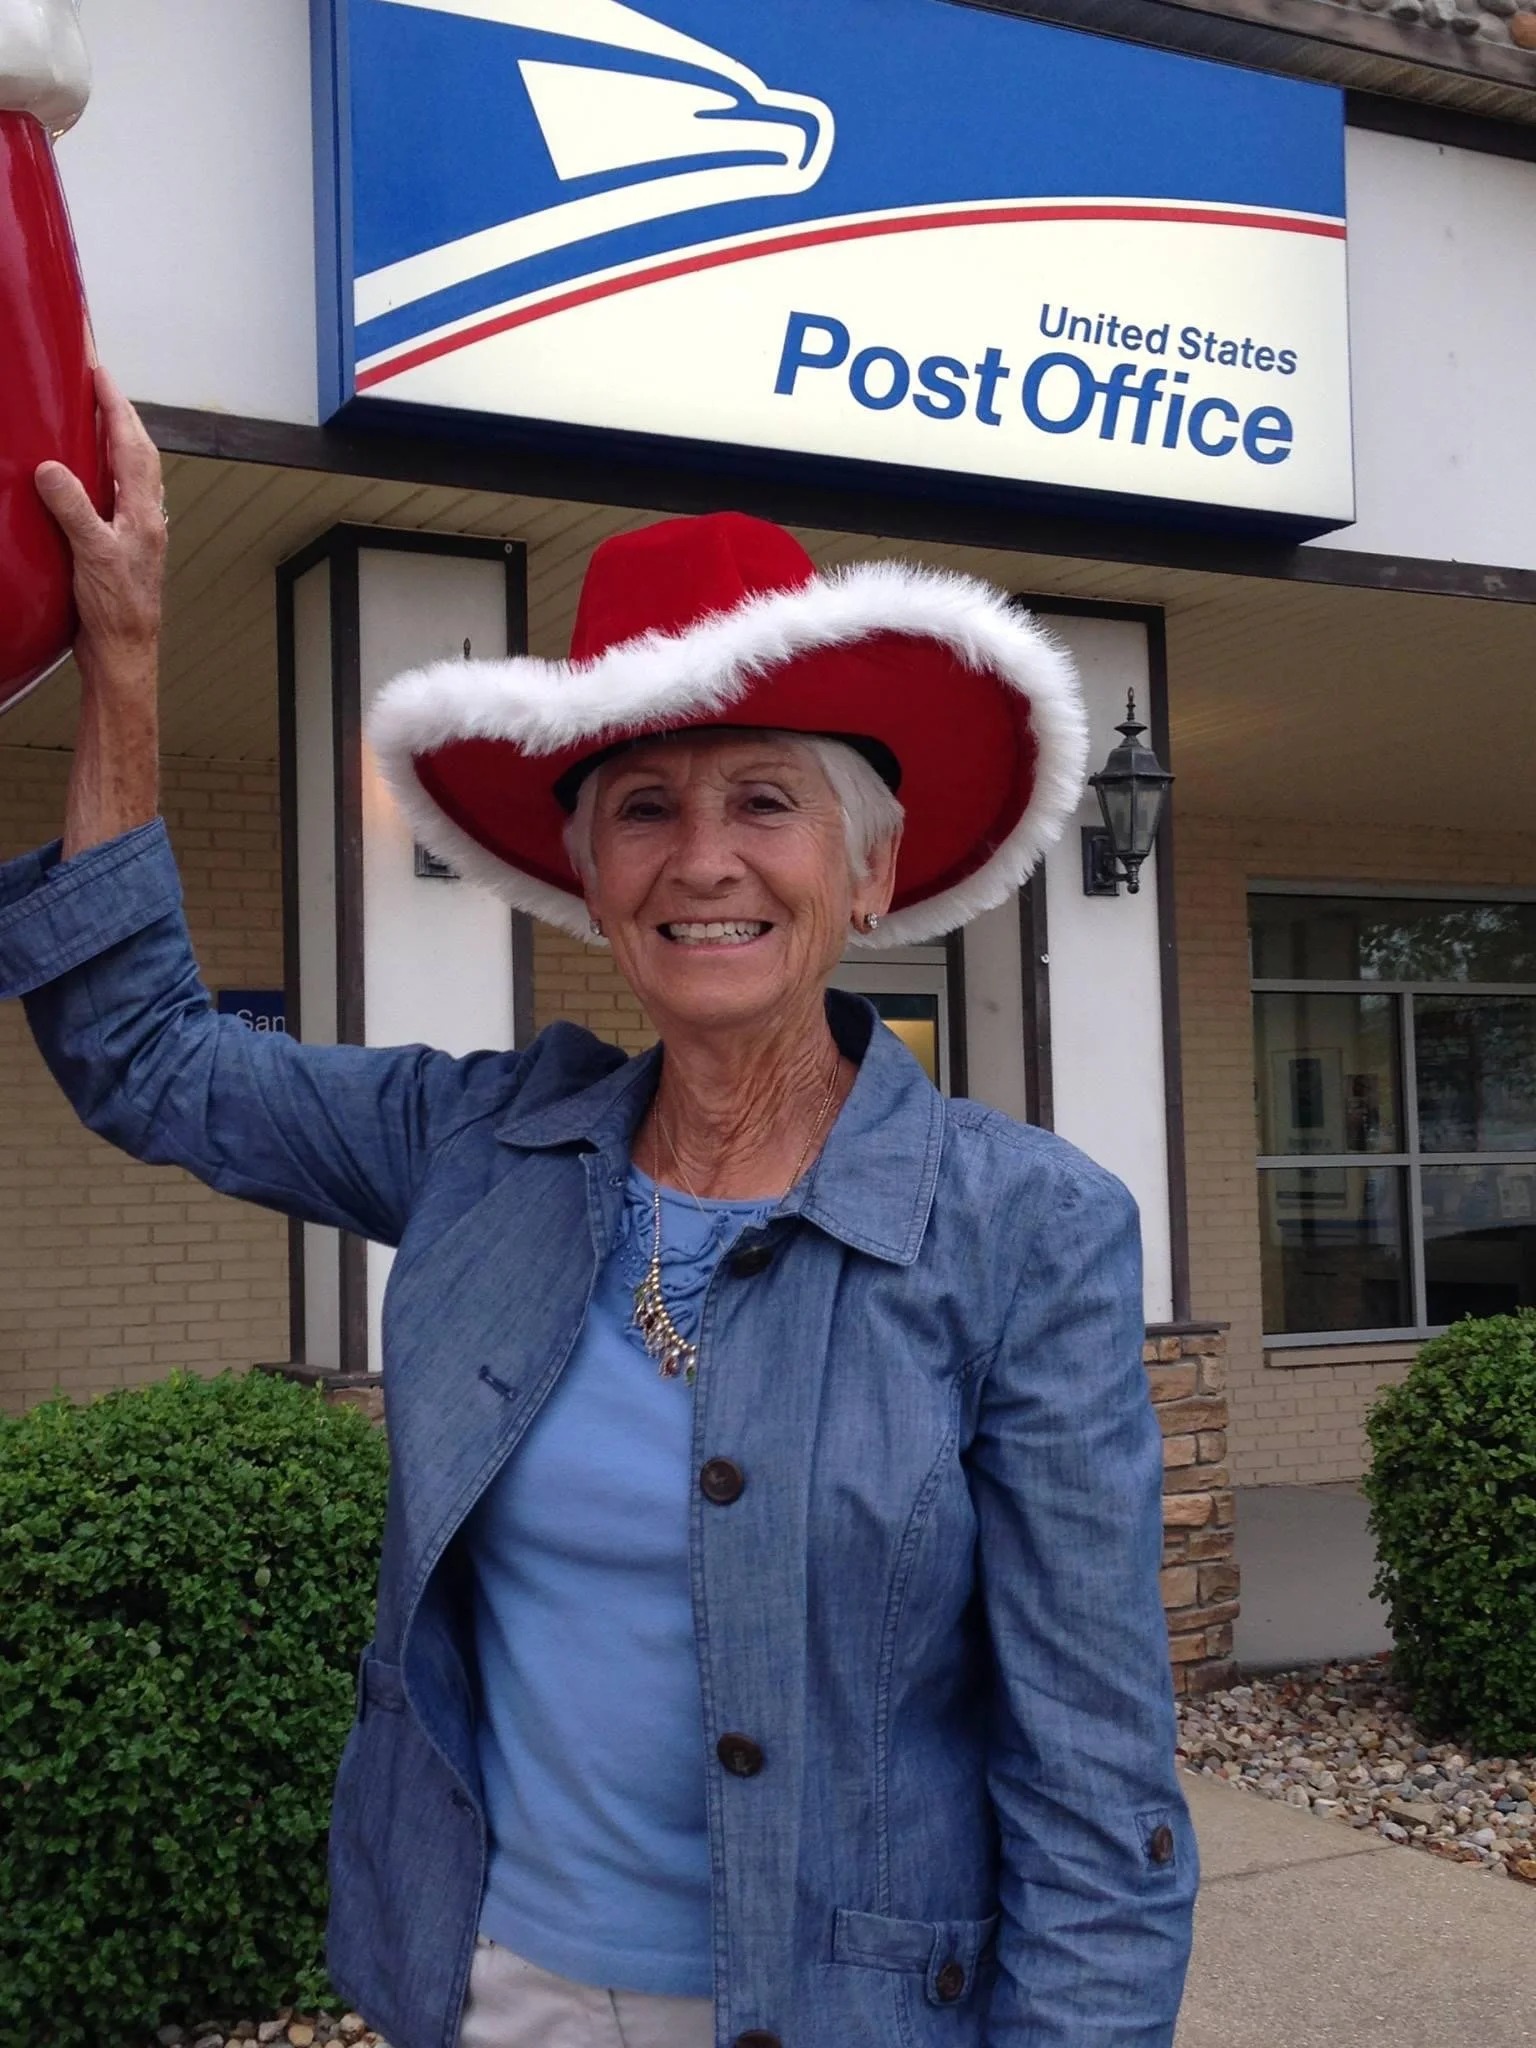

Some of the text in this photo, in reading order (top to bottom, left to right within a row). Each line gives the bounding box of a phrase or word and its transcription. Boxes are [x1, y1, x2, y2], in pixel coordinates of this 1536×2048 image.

[774, 311, 1294, 465] Post Office
[1039, 304, 1298, 374] United States
